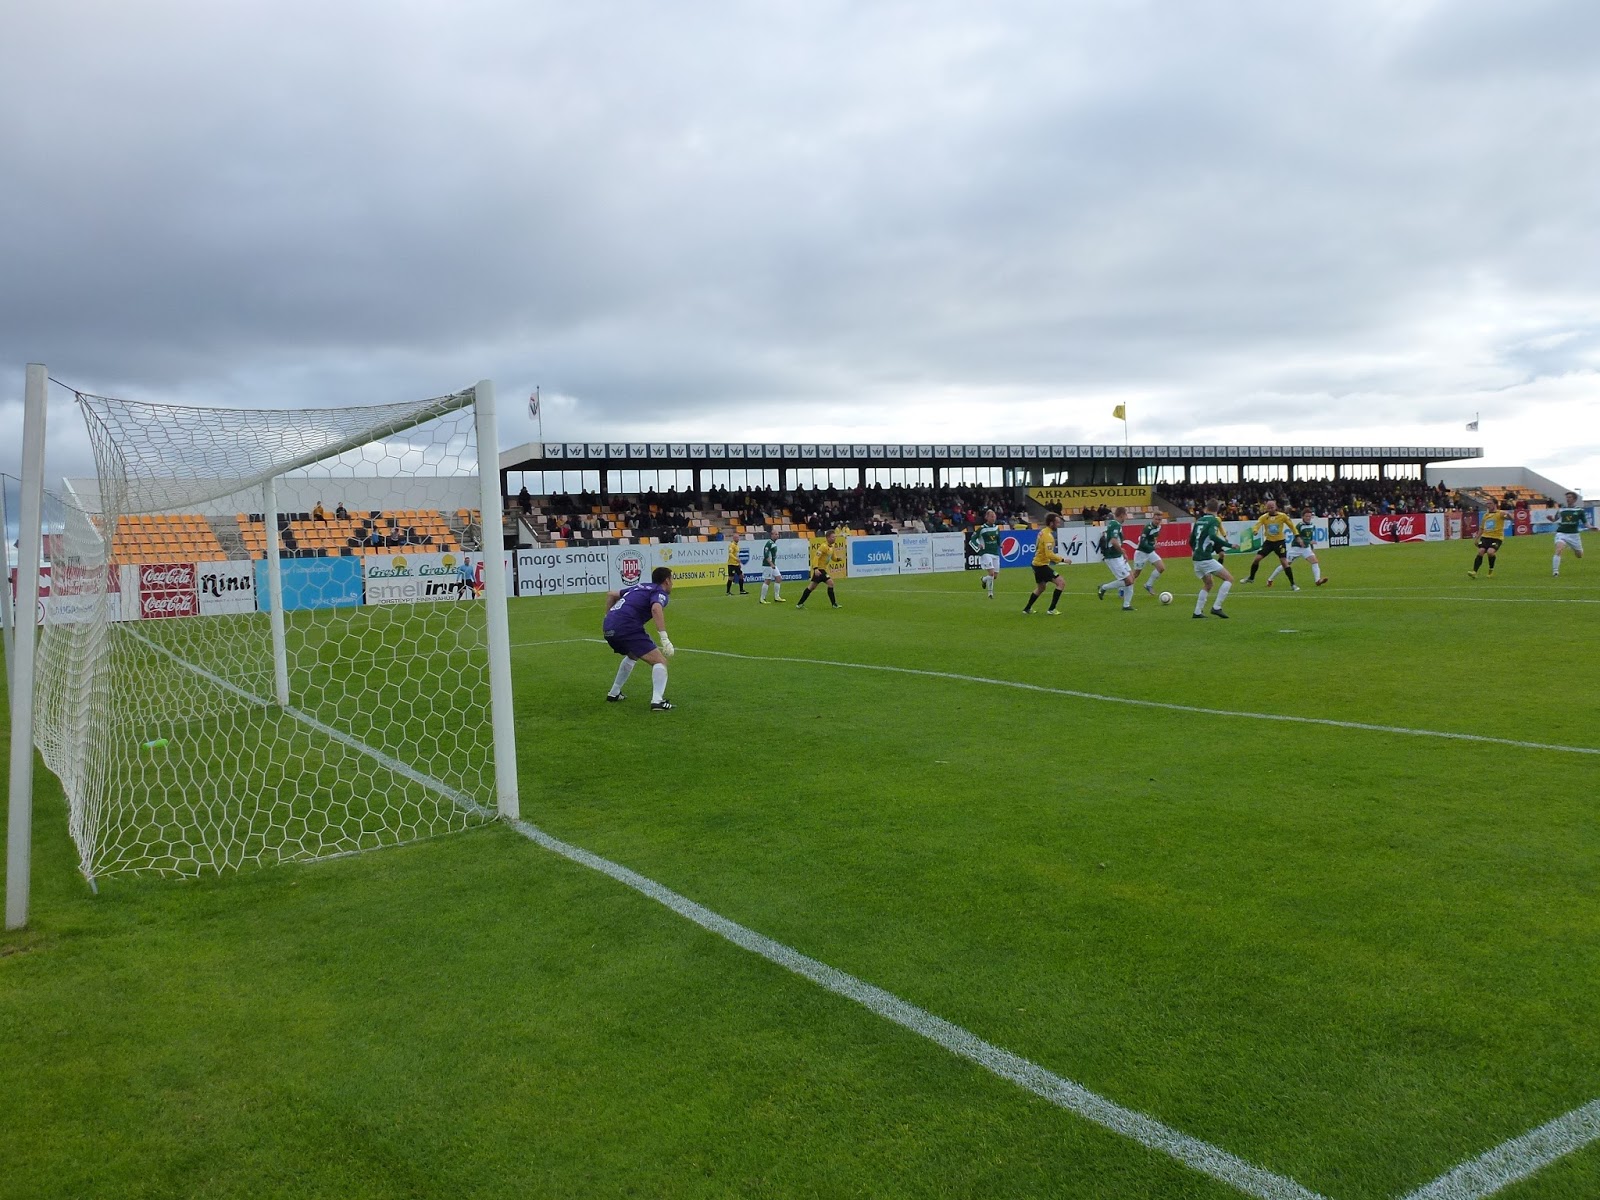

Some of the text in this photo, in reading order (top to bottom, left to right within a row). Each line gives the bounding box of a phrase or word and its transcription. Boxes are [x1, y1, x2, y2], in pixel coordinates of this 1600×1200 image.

[1035, 488, 1147, 498] AKRANESVÖLLUR
[677, 548, 725, 557] MANNVIT
[867, 551, 892, 562] SJÓVÁ
[520, 555, 561, 568] margt
[565, 551, 606, 563] smátt
[520, 574, 607, 591] margt smátt
